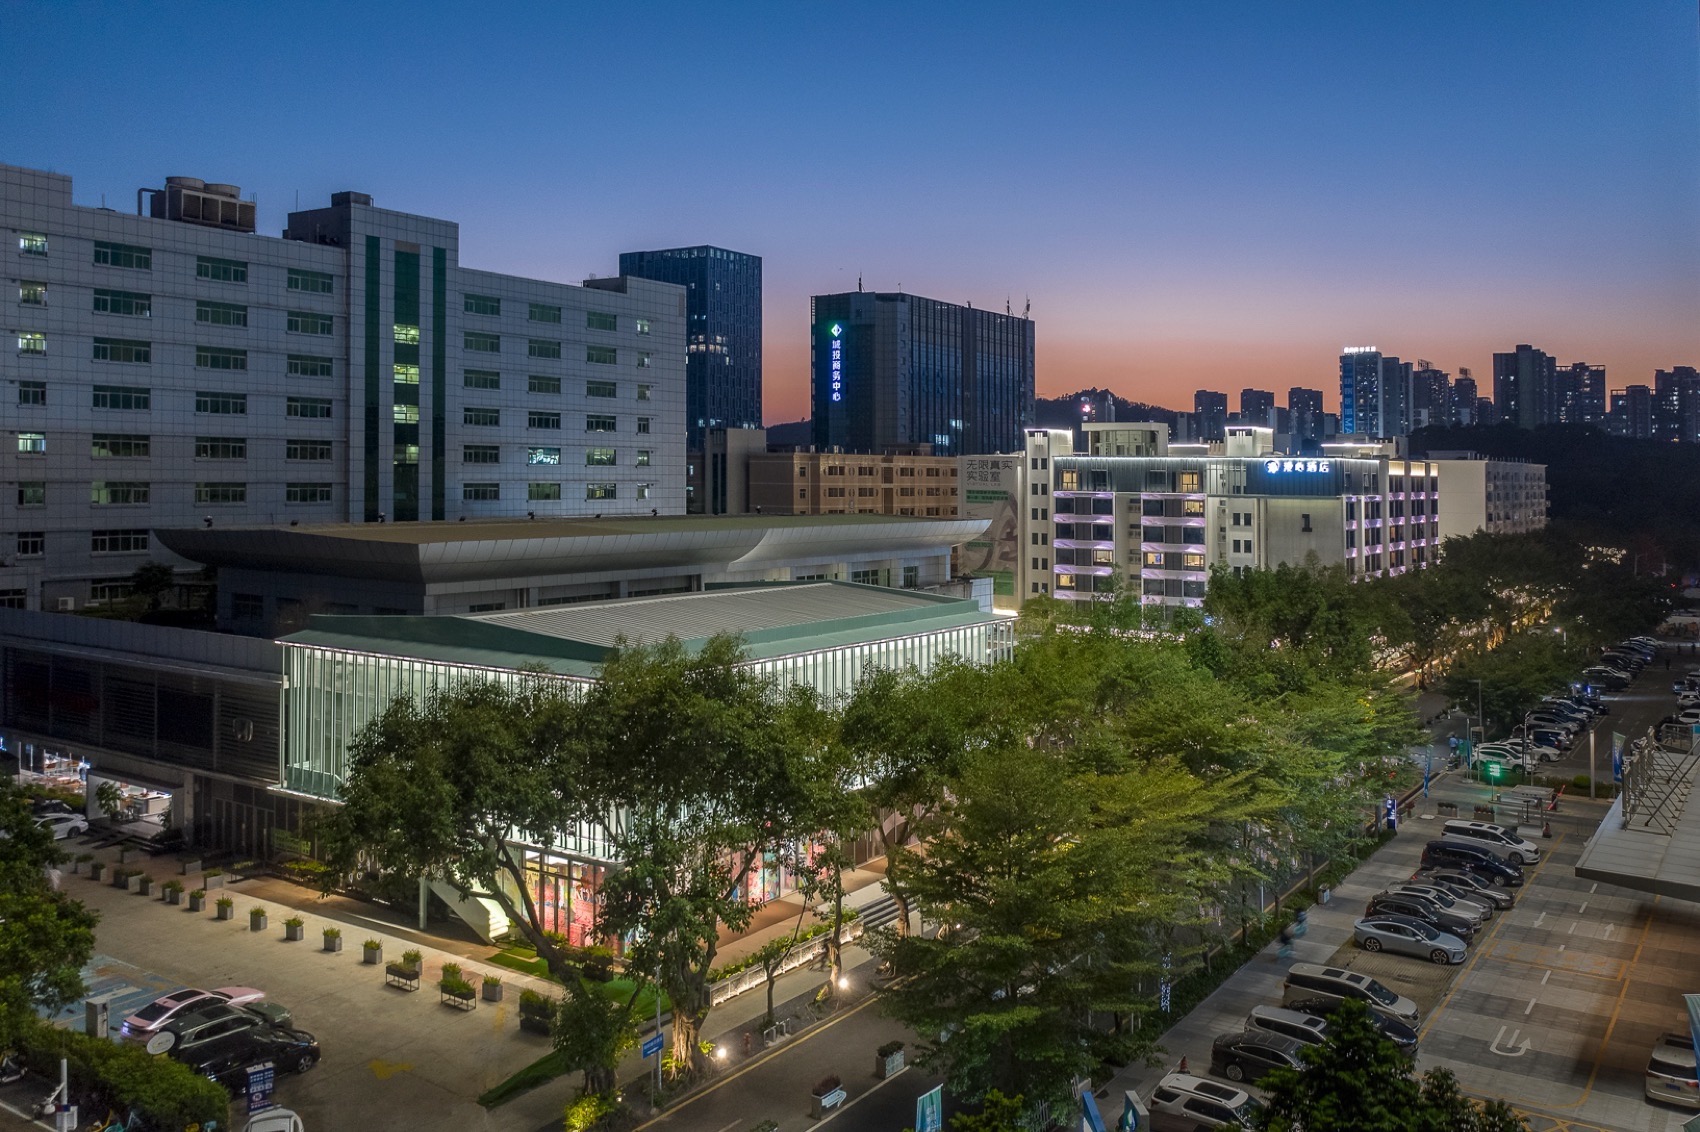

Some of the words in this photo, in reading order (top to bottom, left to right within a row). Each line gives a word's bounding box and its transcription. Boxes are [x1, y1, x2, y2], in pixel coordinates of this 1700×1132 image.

[832, 339, 841, 401] 城投商务中心
[966, 459, 1013, 471] 无限真实
[966, 470, 1001, 482] 实验室
